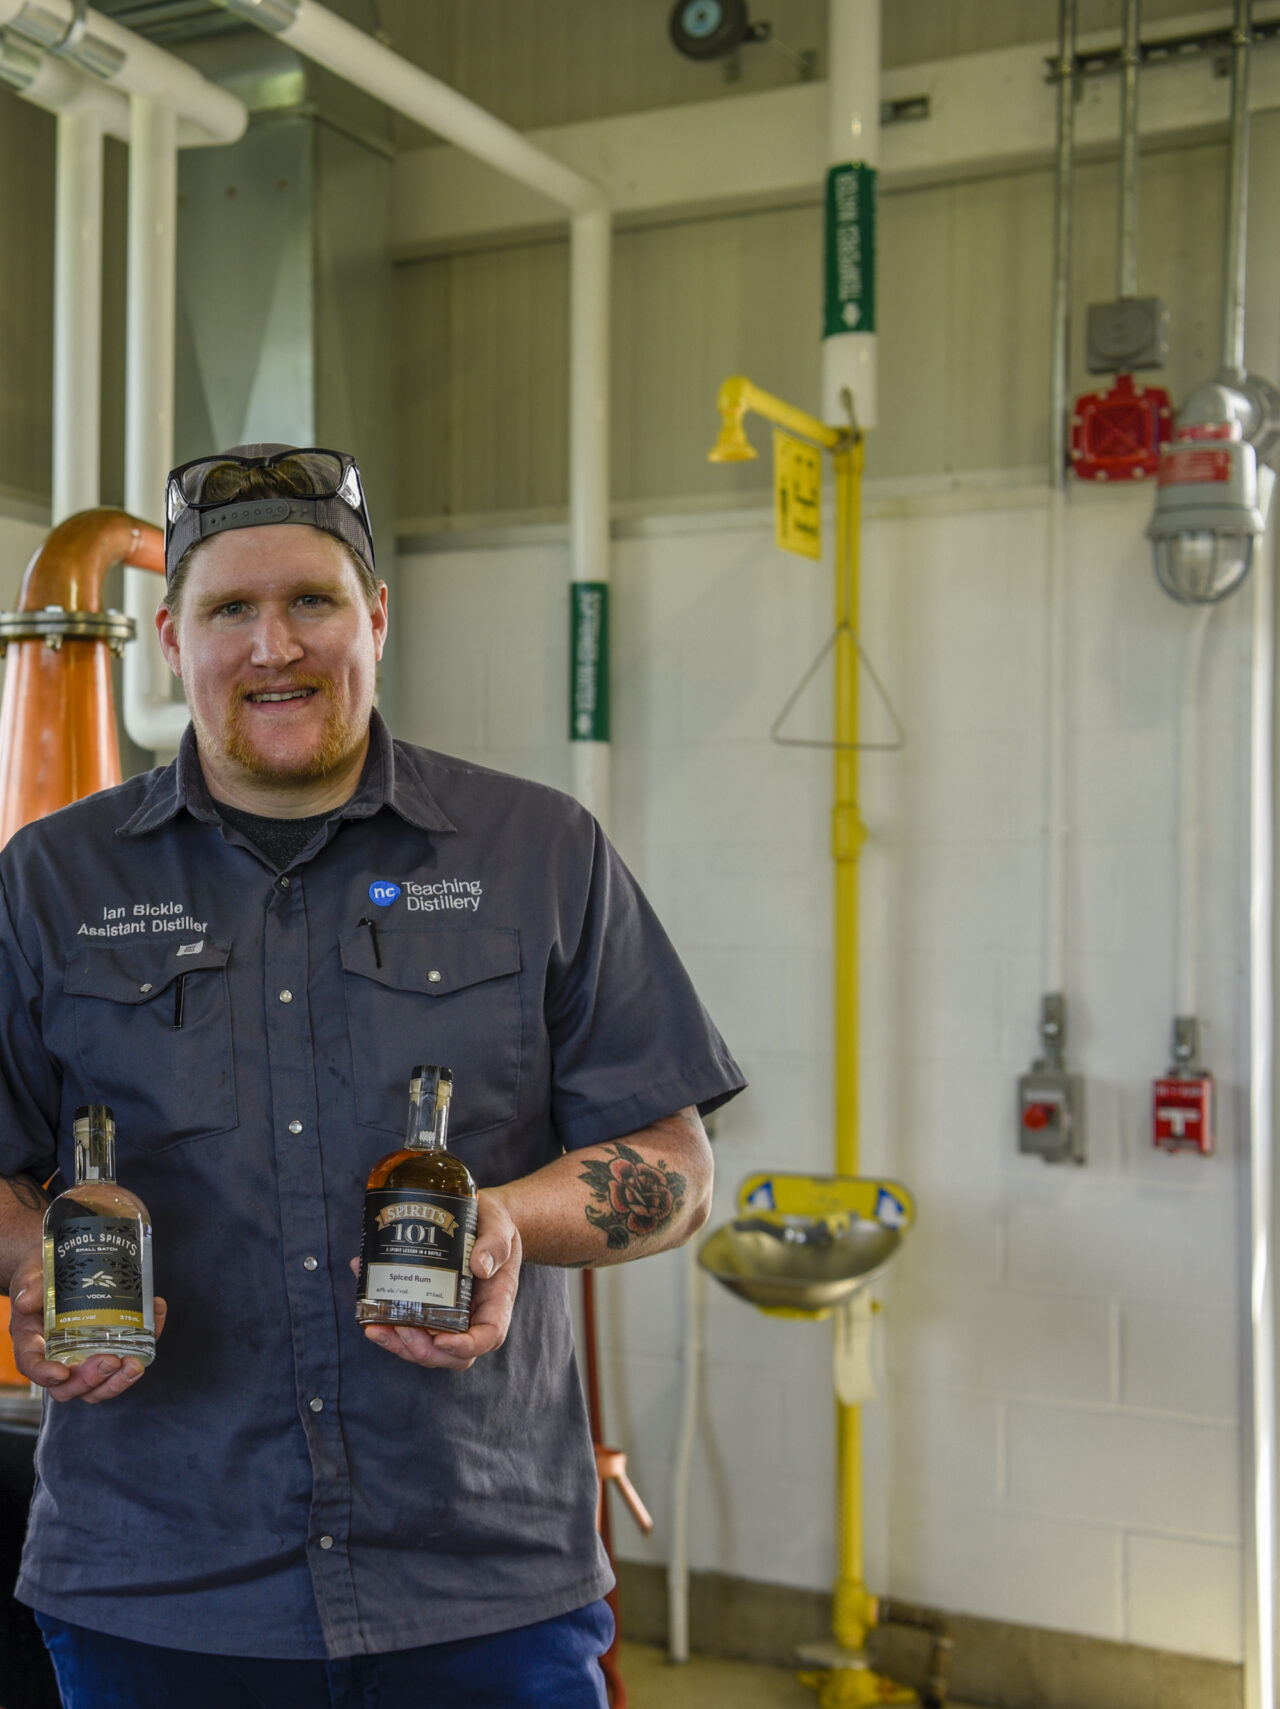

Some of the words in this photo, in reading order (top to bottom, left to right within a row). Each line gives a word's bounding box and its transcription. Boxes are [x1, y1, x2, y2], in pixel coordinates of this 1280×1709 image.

[373, 886, 396, 899] nc
[401, 878, 483, 896] Teaching
[103, 906, 126, 920] Ian
[133, 901, 184, 916] Bickle
[407, 894, 480, 912] Distillery
[77, 920, 146, 937] Assistant
[152, 916, 208, 933] Distiller
[387, 1204, 447, 1224] SPIRITS
[391, 1223, 439, 1246] 101
[57, 1233, 95, 1258] SCHOOL
[99, 1233, 138, 1257] SPIRITS
[389, 1273, 413, 1282] Spiced
[414, 1275, 432, 1283] Rum
